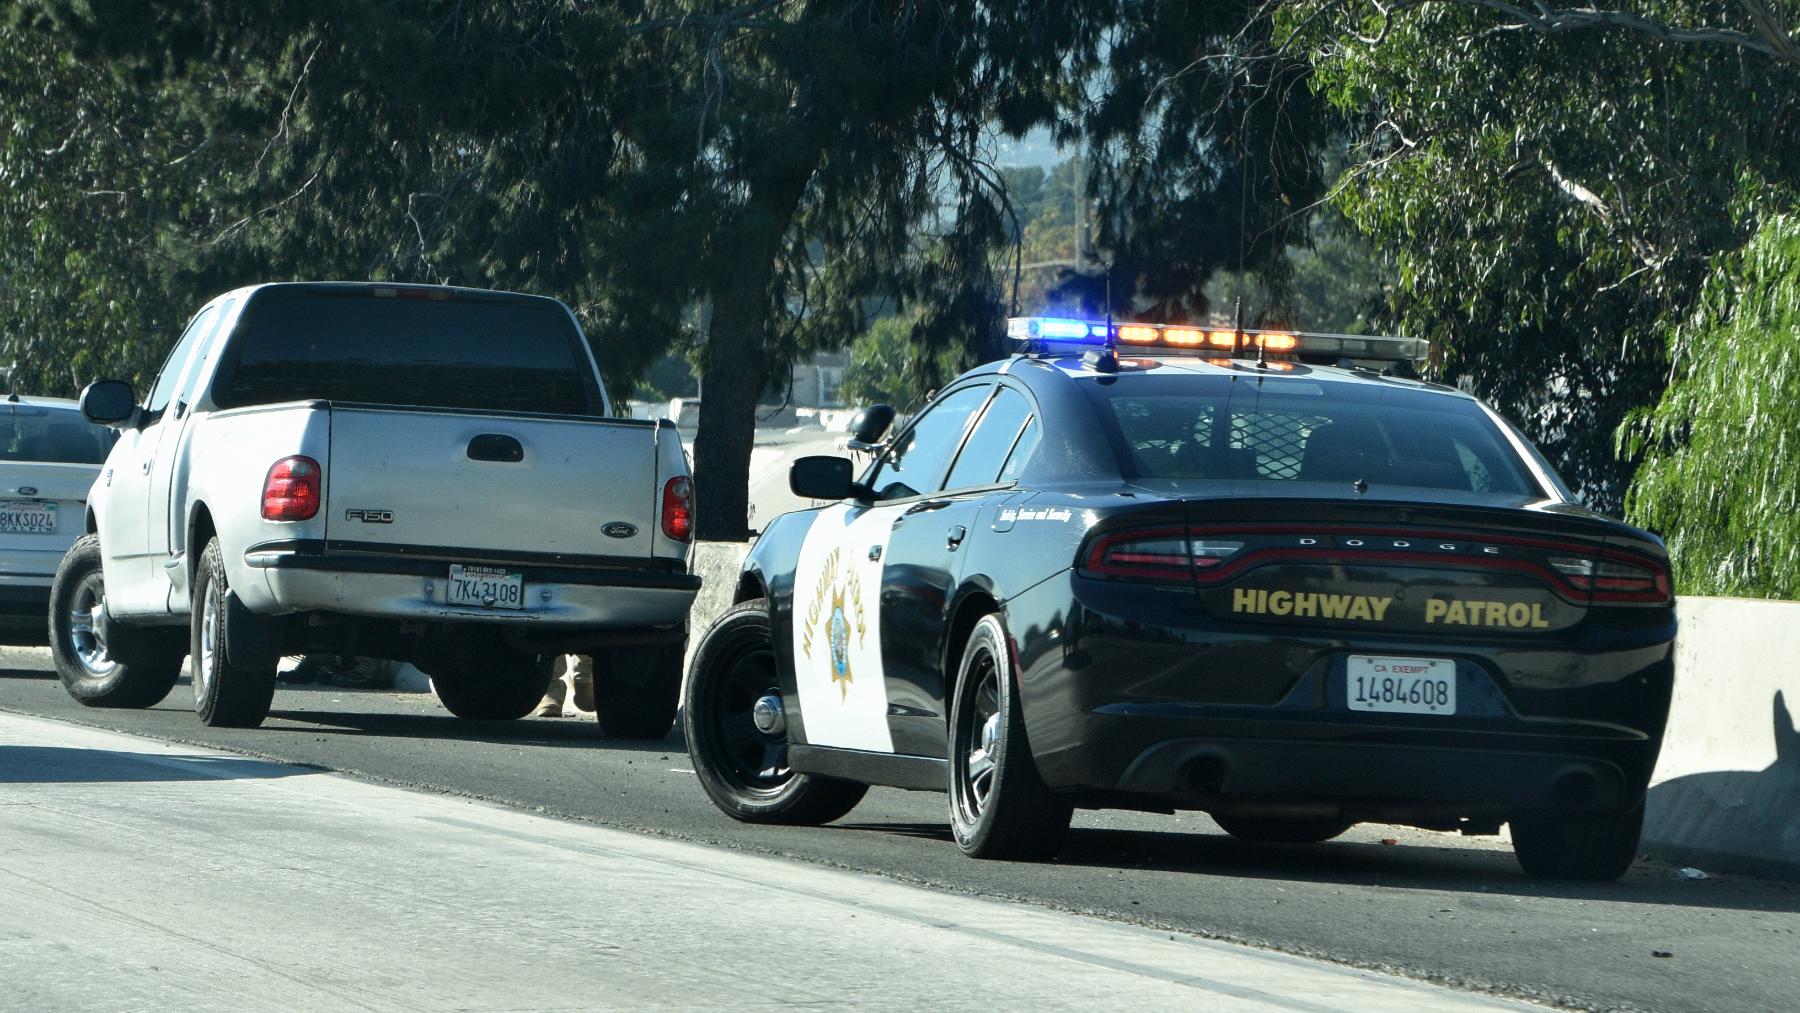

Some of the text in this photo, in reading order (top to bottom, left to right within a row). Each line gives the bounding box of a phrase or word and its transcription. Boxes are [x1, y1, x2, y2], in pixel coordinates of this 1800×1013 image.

[0, 512, 53, 527] 8KKS024
[1300, 538, 1499, 554] DODGE
[803, 547, 840, 659] HIGHWAY
[1233, 588, 1548, 628] HIGHWAY PATROL
[1374, 665, 1429, 674] CA EXEMPT
[1355, 676, 1448, 706] 1484608
